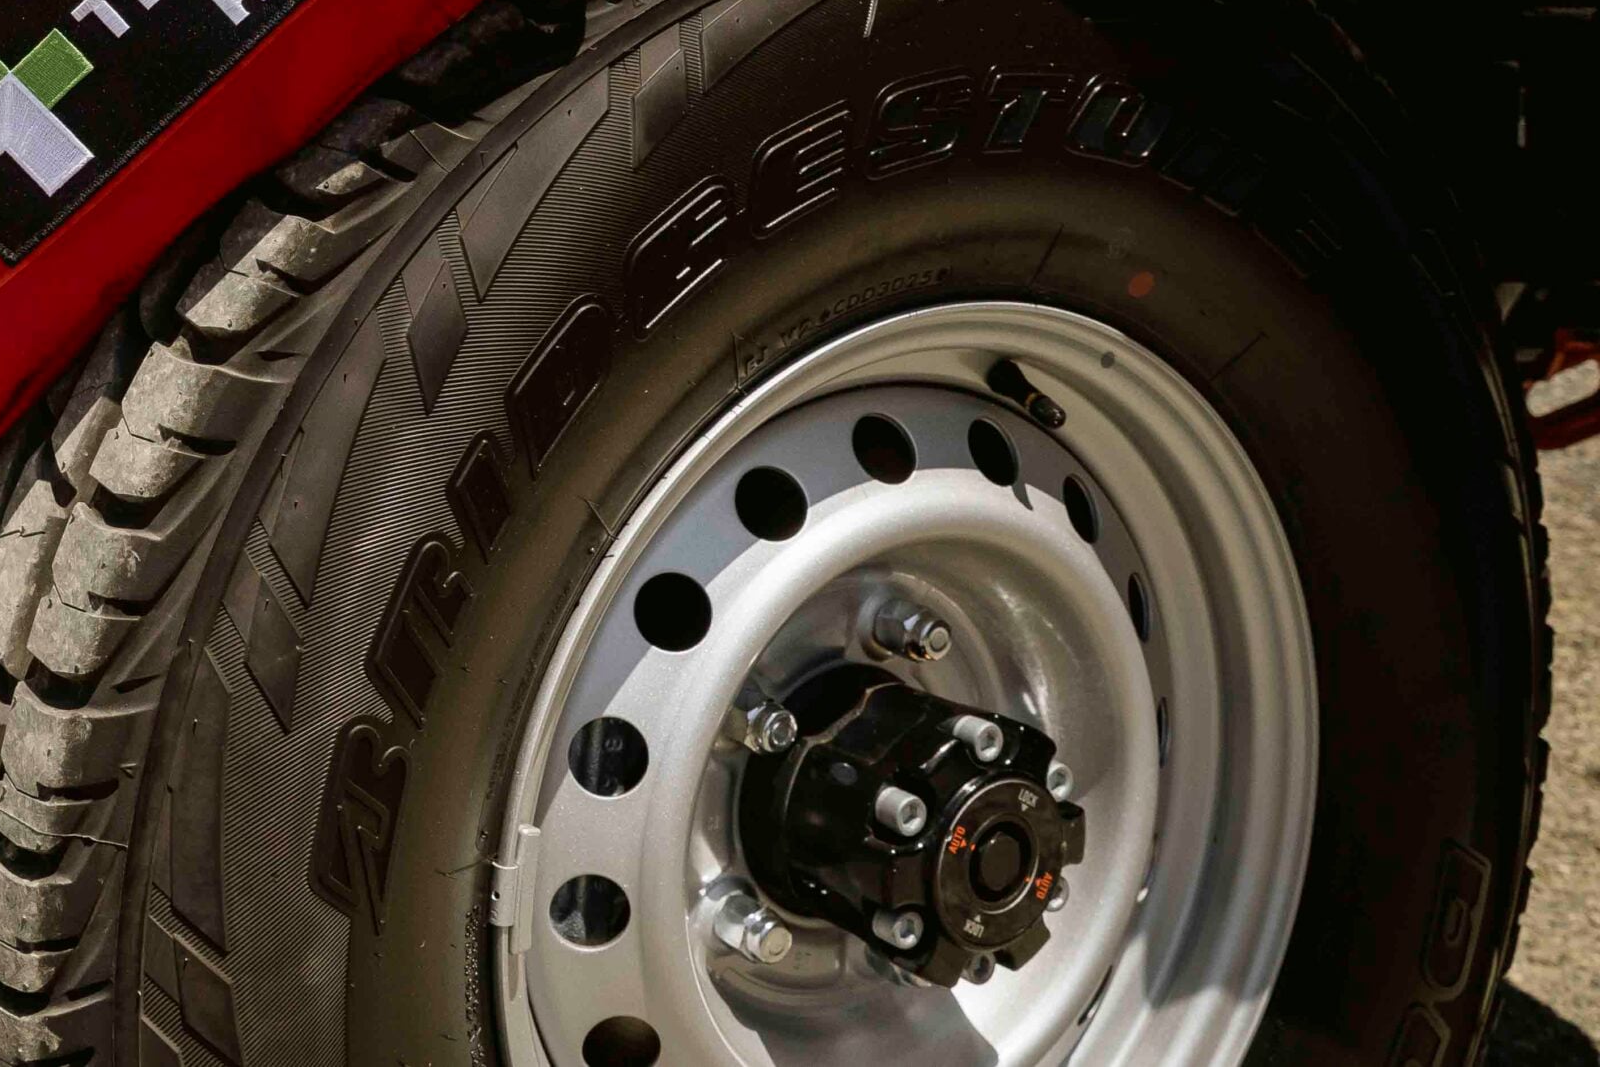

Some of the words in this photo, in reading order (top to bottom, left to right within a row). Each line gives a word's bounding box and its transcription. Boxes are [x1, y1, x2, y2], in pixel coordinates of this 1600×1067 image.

[311, 62, 1342, 936] BRIDGESTO
[1018, 789, 1039, 808] LOCK
[948, 825, 966, 854] AUTO
[1036, 872, 1054, 900] AUTO
